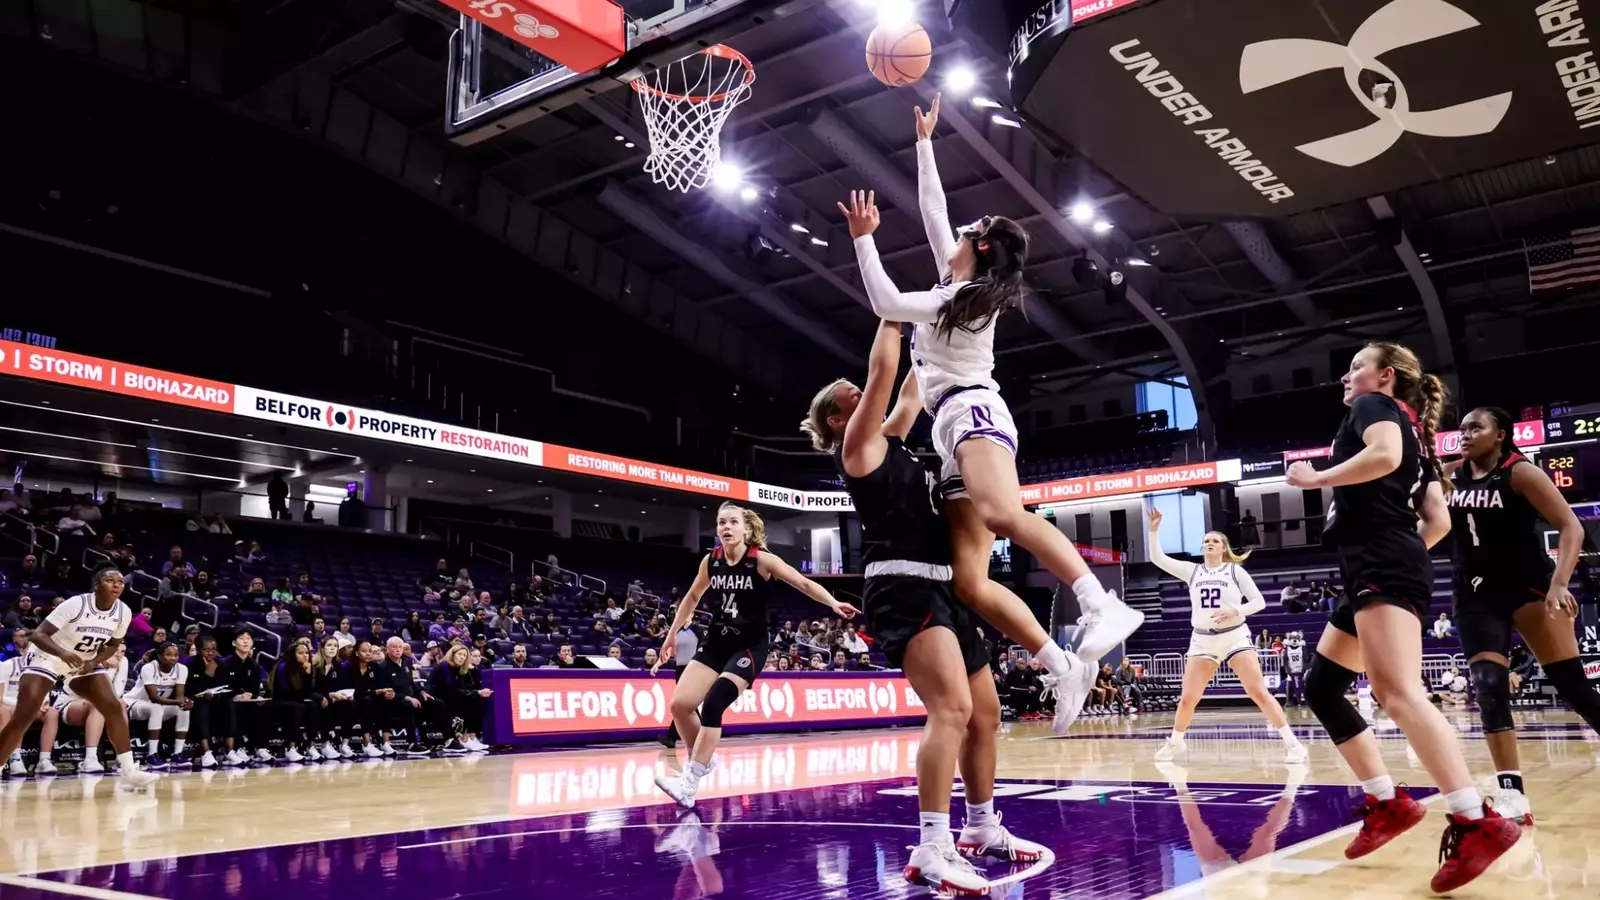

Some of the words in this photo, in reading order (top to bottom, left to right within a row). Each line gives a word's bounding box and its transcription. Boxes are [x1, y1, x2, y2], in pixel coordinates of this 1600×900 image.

[1072, 0, 1104, 18] FOULS
[1109, 38, 1213, 125] UNDER
[1194, 128, 1295, 203] ARMOUR
[29, 354, 103, 382] STORM
[124, 372, 230, 404] BIOHAZARD
[255, 396, 321, 421] BELFOR
[359, 415, 437, 441] PROPERTY
[440, 430, 529, 457] RESTORATION
[971, 405, 994, 428] N
[1547, 422, 1561, 430] QTR
[567, 453, 626, 474] RESTORING
[628, 463, 657, 480] MORE
[659, 469, 683, 485] THAN
[685, 474, 730, 493] PROPERTY
[1549, 456, 1574, 469] 2:22
[758, 488, 789, 503] BELFOR
[1020, 488, 1041, 500] FIRE
[1052, 485, 1082, 497] MOLD
[1094, 477, 1133, 492] STORM
[1145, 468, 1214, 486] BIOHAZARD
[1467, 513, 1480, 546] 1
[711, 575, 753, 590] OMAHA
[1200, 588, 1221, 608] 22
[518, 690, 618, 720] BELFOR
[805, 688, 867, 710] BELFOR
